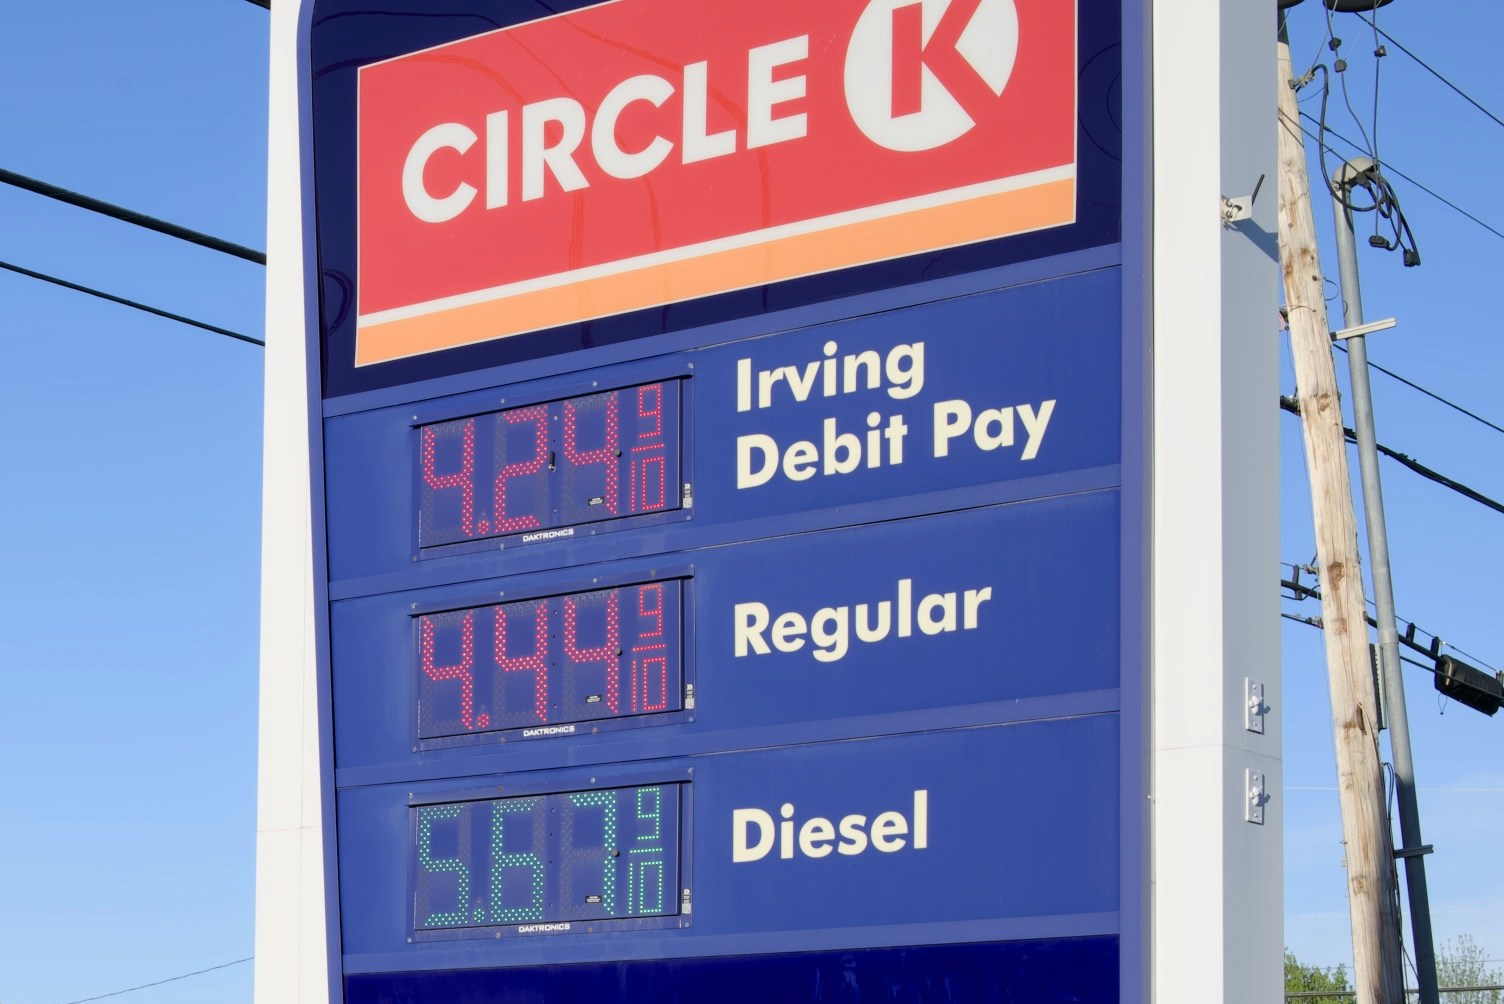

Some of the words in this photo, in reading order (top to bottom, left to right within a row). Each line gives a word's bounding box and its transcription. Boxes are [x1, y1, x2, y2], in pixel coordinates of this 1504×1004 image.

[402, 34, 808, 223] CIRCLE
[890, 0, 1002, 125] K
[737, 340, 924, 412] Irving
[423, 391, 619, 537] 4.24
[737, 412, 908, 489] Debit
[934, 399, 1057, 461] Pay
[522, 528, 575, 543] DAKTRONICS
[421, 589, 619, 731] 4.44
[734, 578, 992, 662] Regular
[522, 725, 575, 738] DAKTRONICS
[419, 791, 617, 926] 5.67
[733, 789, 928, 863] Diesel
[518, 923, 571, 934] DAKTRONICS
